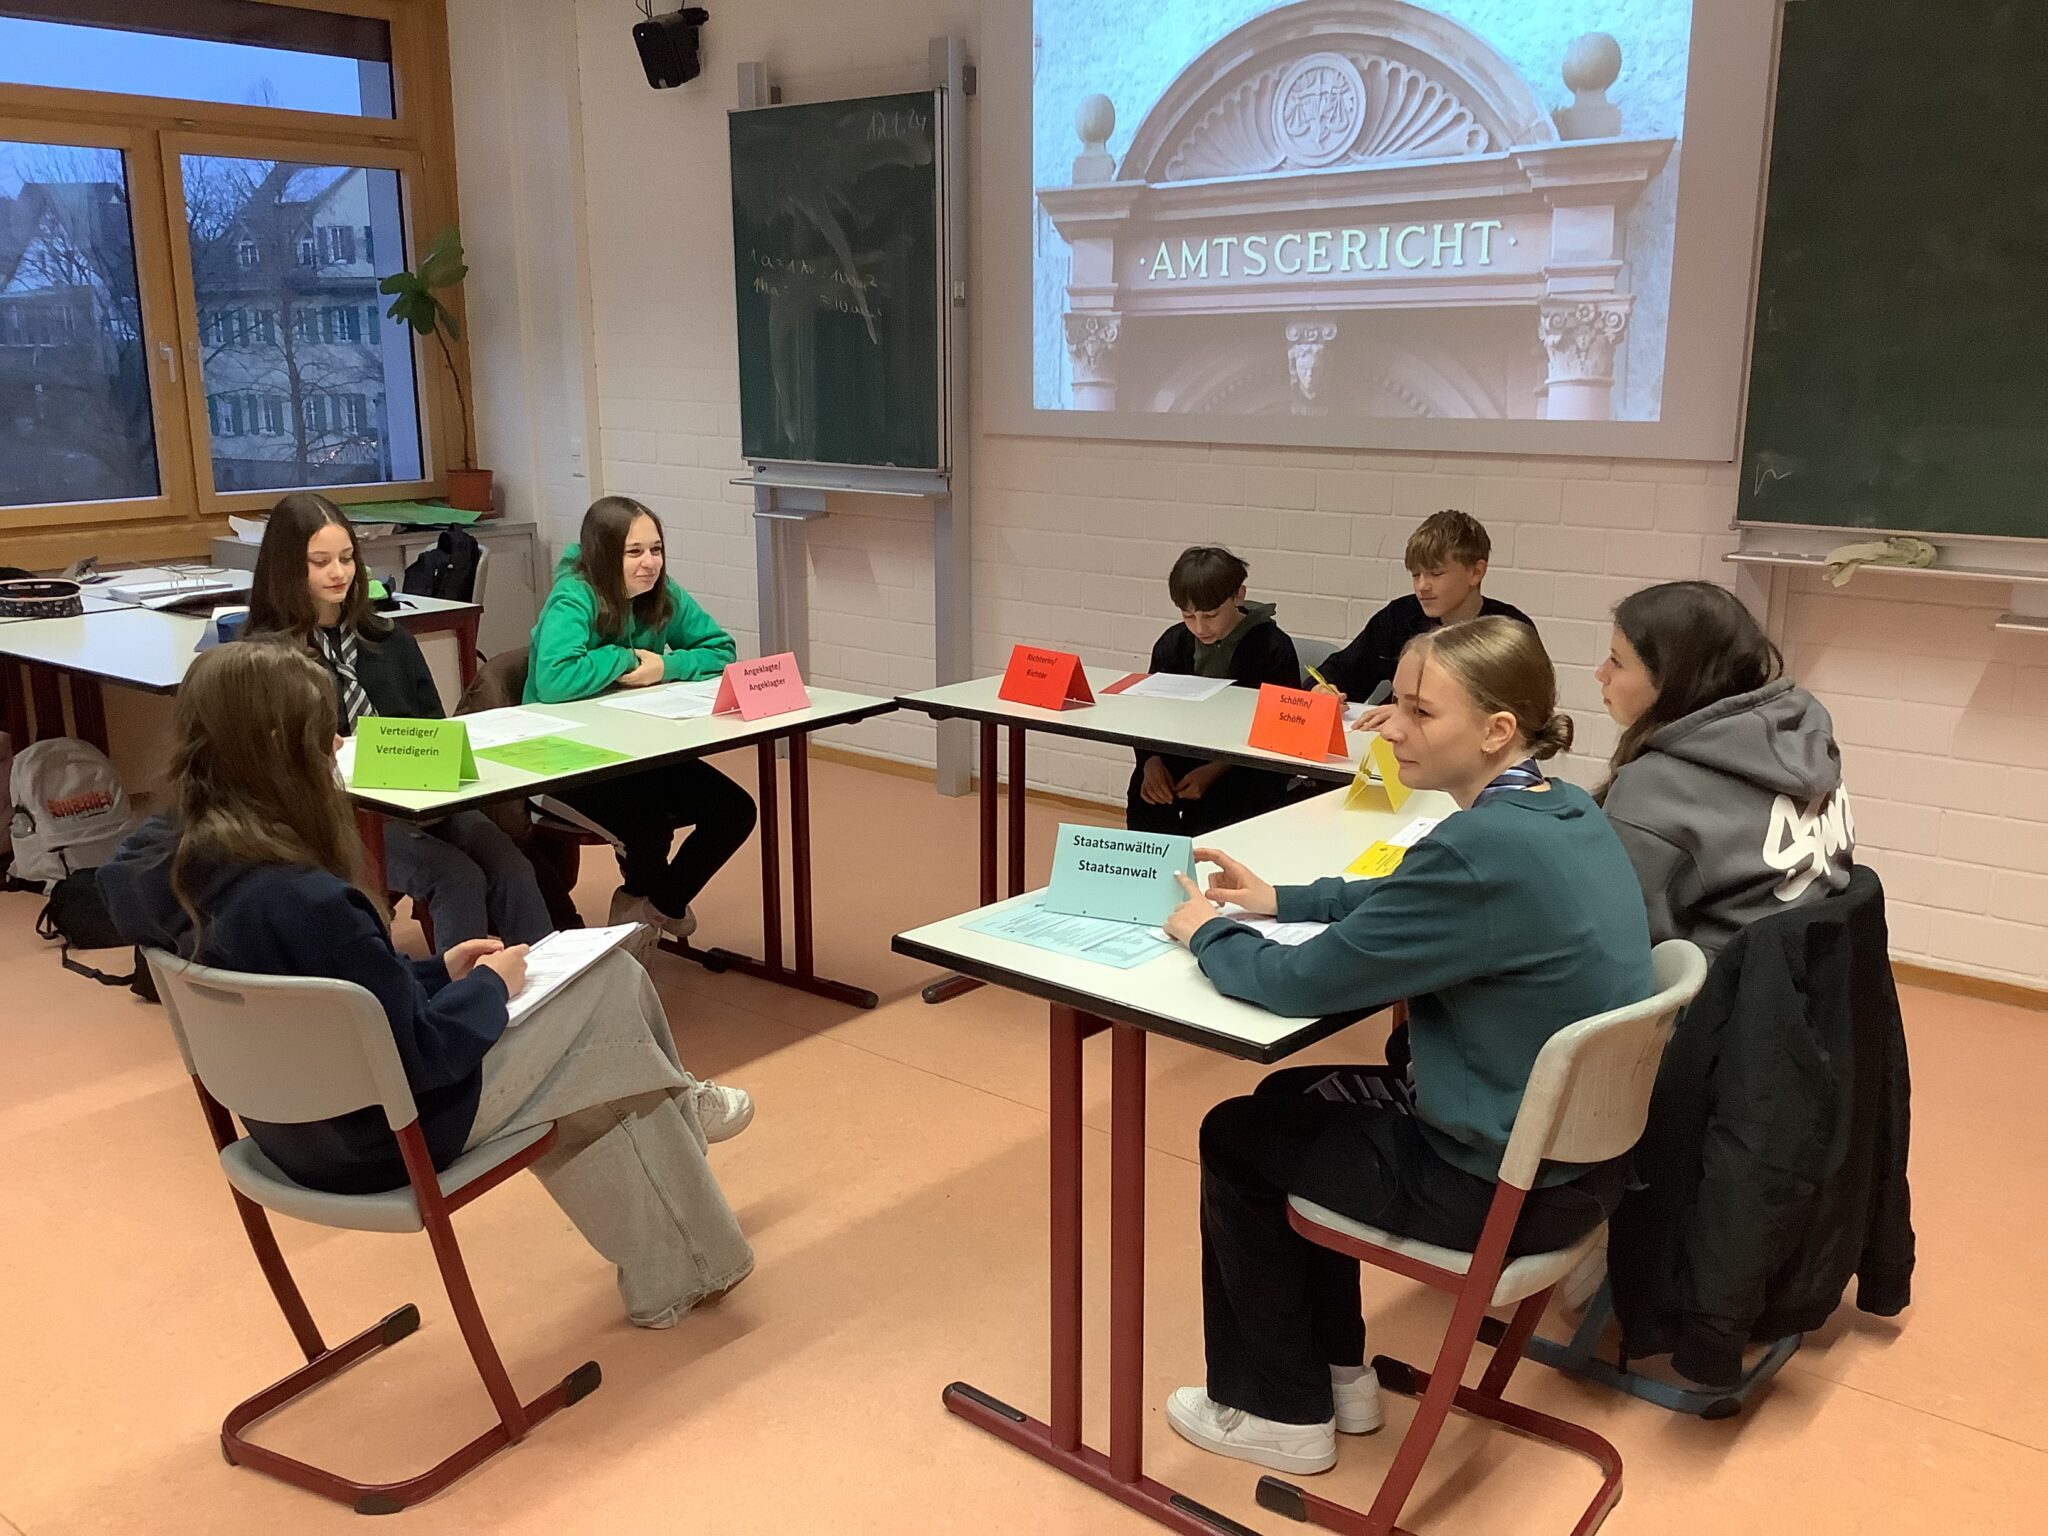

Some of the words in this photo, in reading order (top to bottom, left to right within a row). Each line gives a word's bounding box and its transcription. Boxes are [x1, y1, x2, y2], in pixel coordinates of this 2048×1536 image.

[1148, 220, 1502, 280] AMTSGERICHT
[1026, 653, 1058, 667] Richterin/
[743, 661, 781, 676] Angeklagte/
[1025, 668, 1048, 679] Richter
[749, 678, 786, 691] Angeklagter
[1280, 694, 1313, 710] Schöffin/
[1279, 712, 1306, 726] Schöffe
[379, 726, 440, 739] Verteidiger/
[376, 744, 440, 758] Verteidigerin
[1073, 834, 1170, 858] Staatsanwältin/
[1078, 859, 1157, 880] Staatsanwalt
